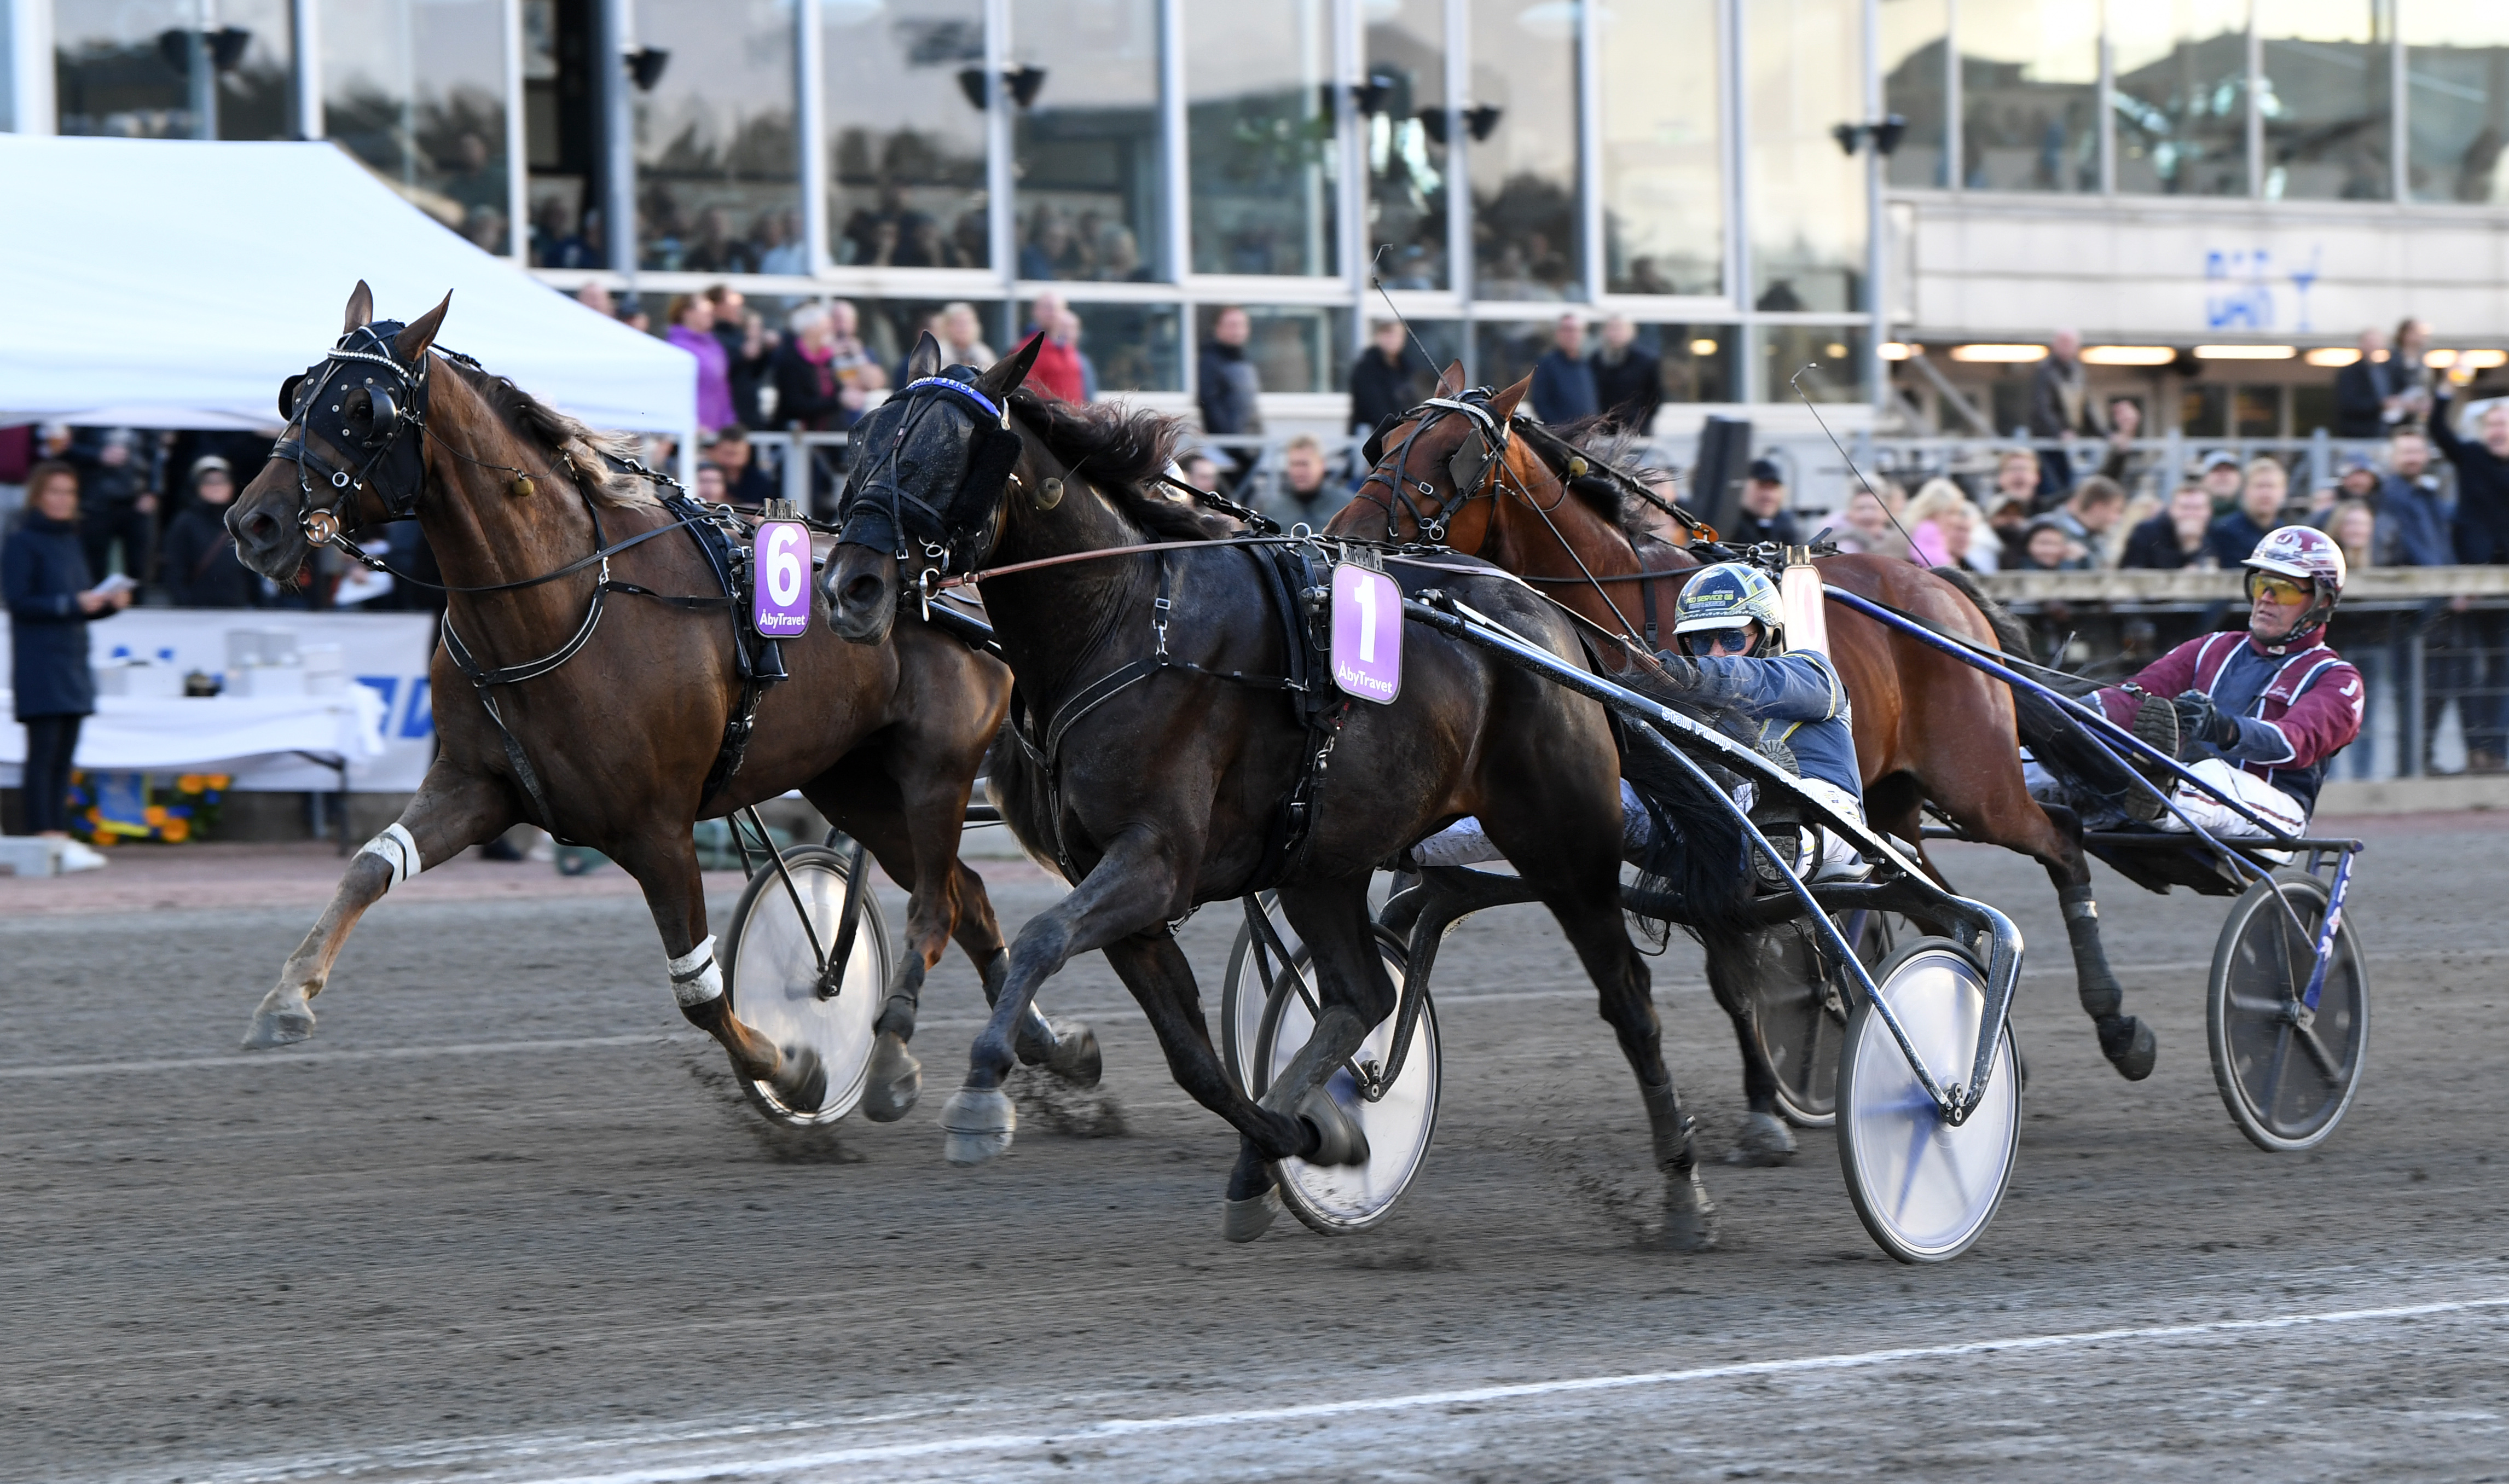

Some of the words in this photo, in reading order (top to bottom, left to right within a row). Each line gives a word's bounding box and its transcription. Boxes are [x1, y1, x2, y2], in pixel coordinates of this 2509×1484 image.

[941, 378, 975, 395] BRICK
[767, 525, 801, 607] 6
[1696, 594, 1723, 602] SERVICE
[1782, 571, 1823, 650] 10
[760, 608, 806, 629] ÅbyTravet
[1354, 575, 1376, 663] 1
[1338, 660, 1393, 694] ÅbyTravet
[1661, 706, 1691, 731] Stall
